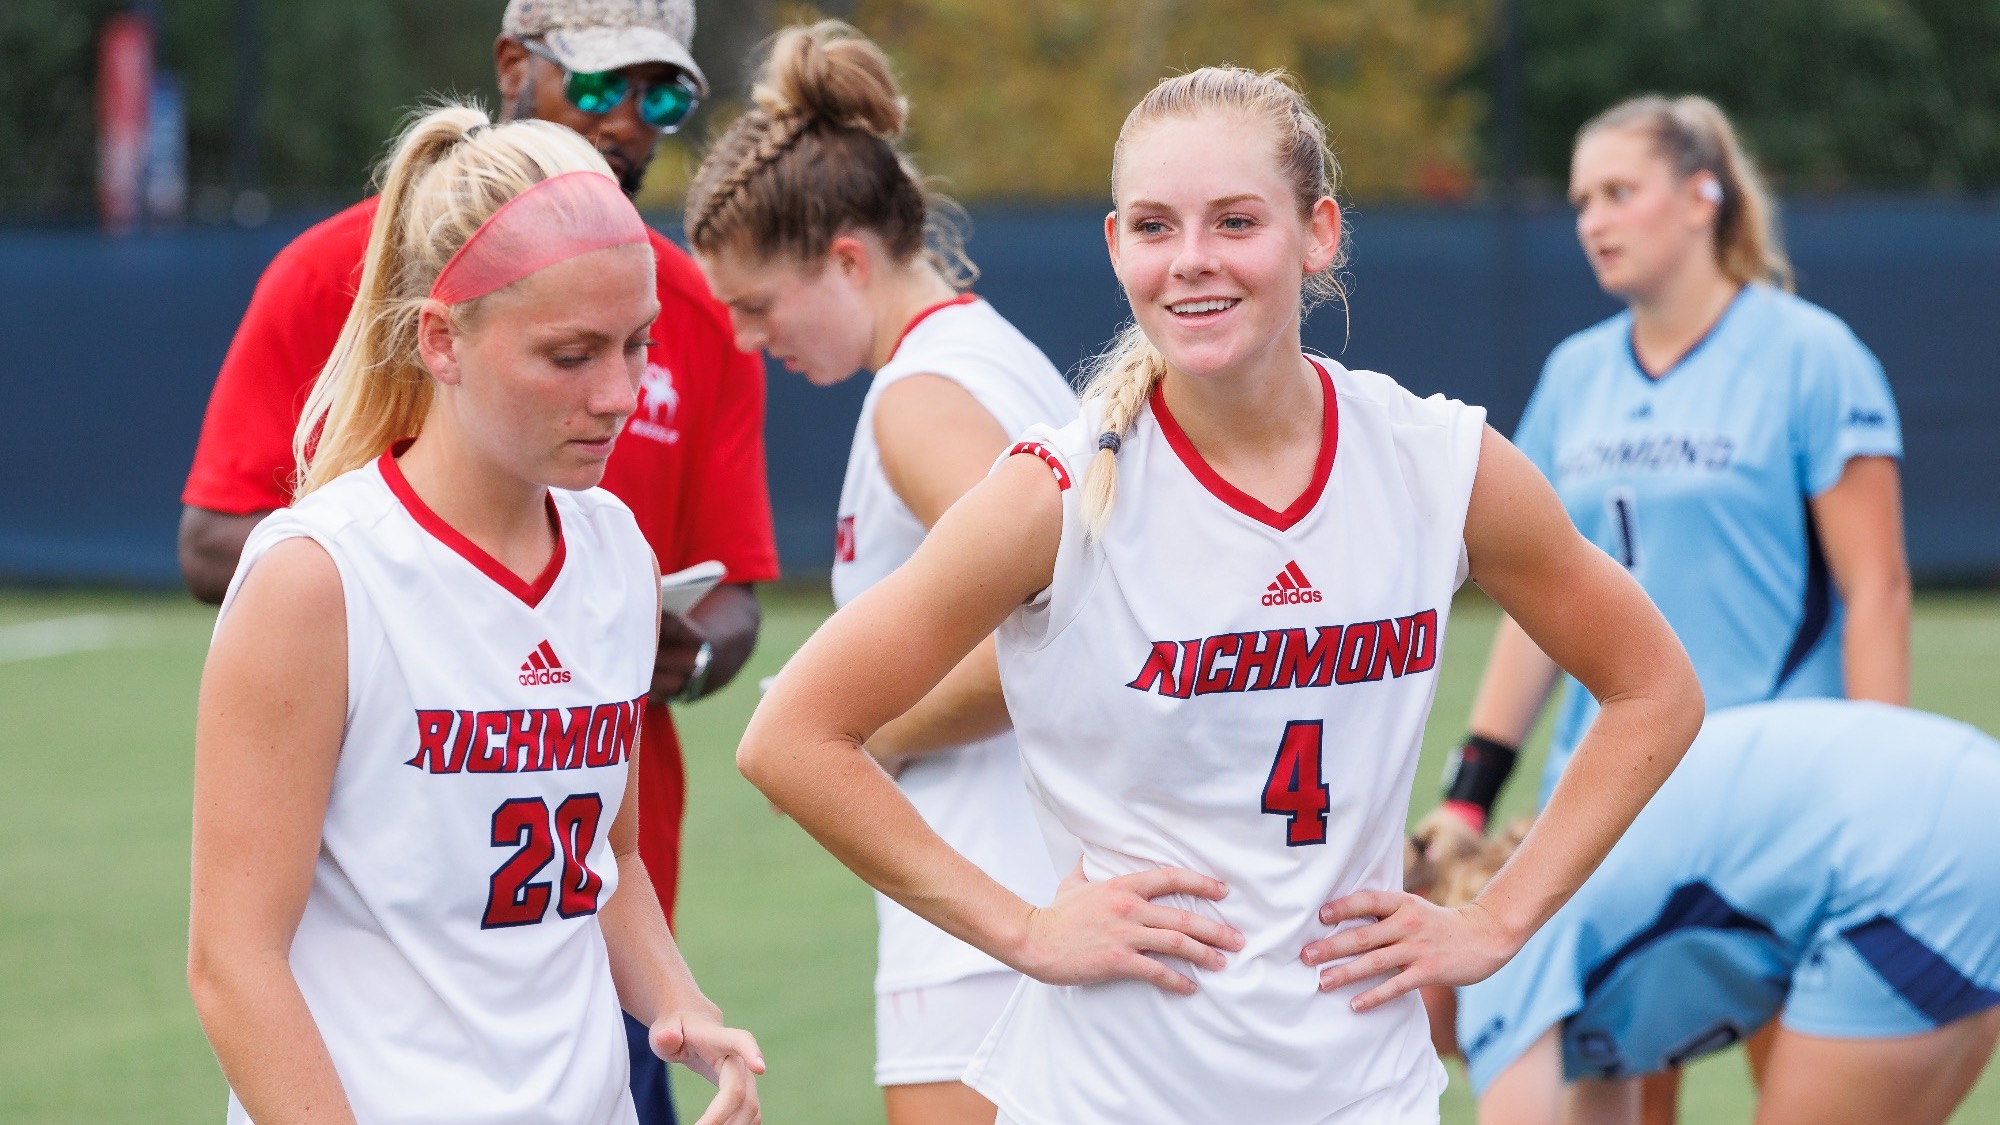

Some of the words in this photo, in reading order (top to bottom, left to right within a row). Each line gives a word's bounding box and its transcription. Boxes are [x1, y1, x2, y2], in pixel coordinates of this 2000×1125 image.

[1261, 587, 1323, 607] adidas
[518, 668, 571, 687] adidas
[1125, 608, 1437, 700] RICHMOND
[403, 691, 648, 774] RICHMON
[1260, 718, 1331, 847] 4
[480, 792, 603, 930] 20
